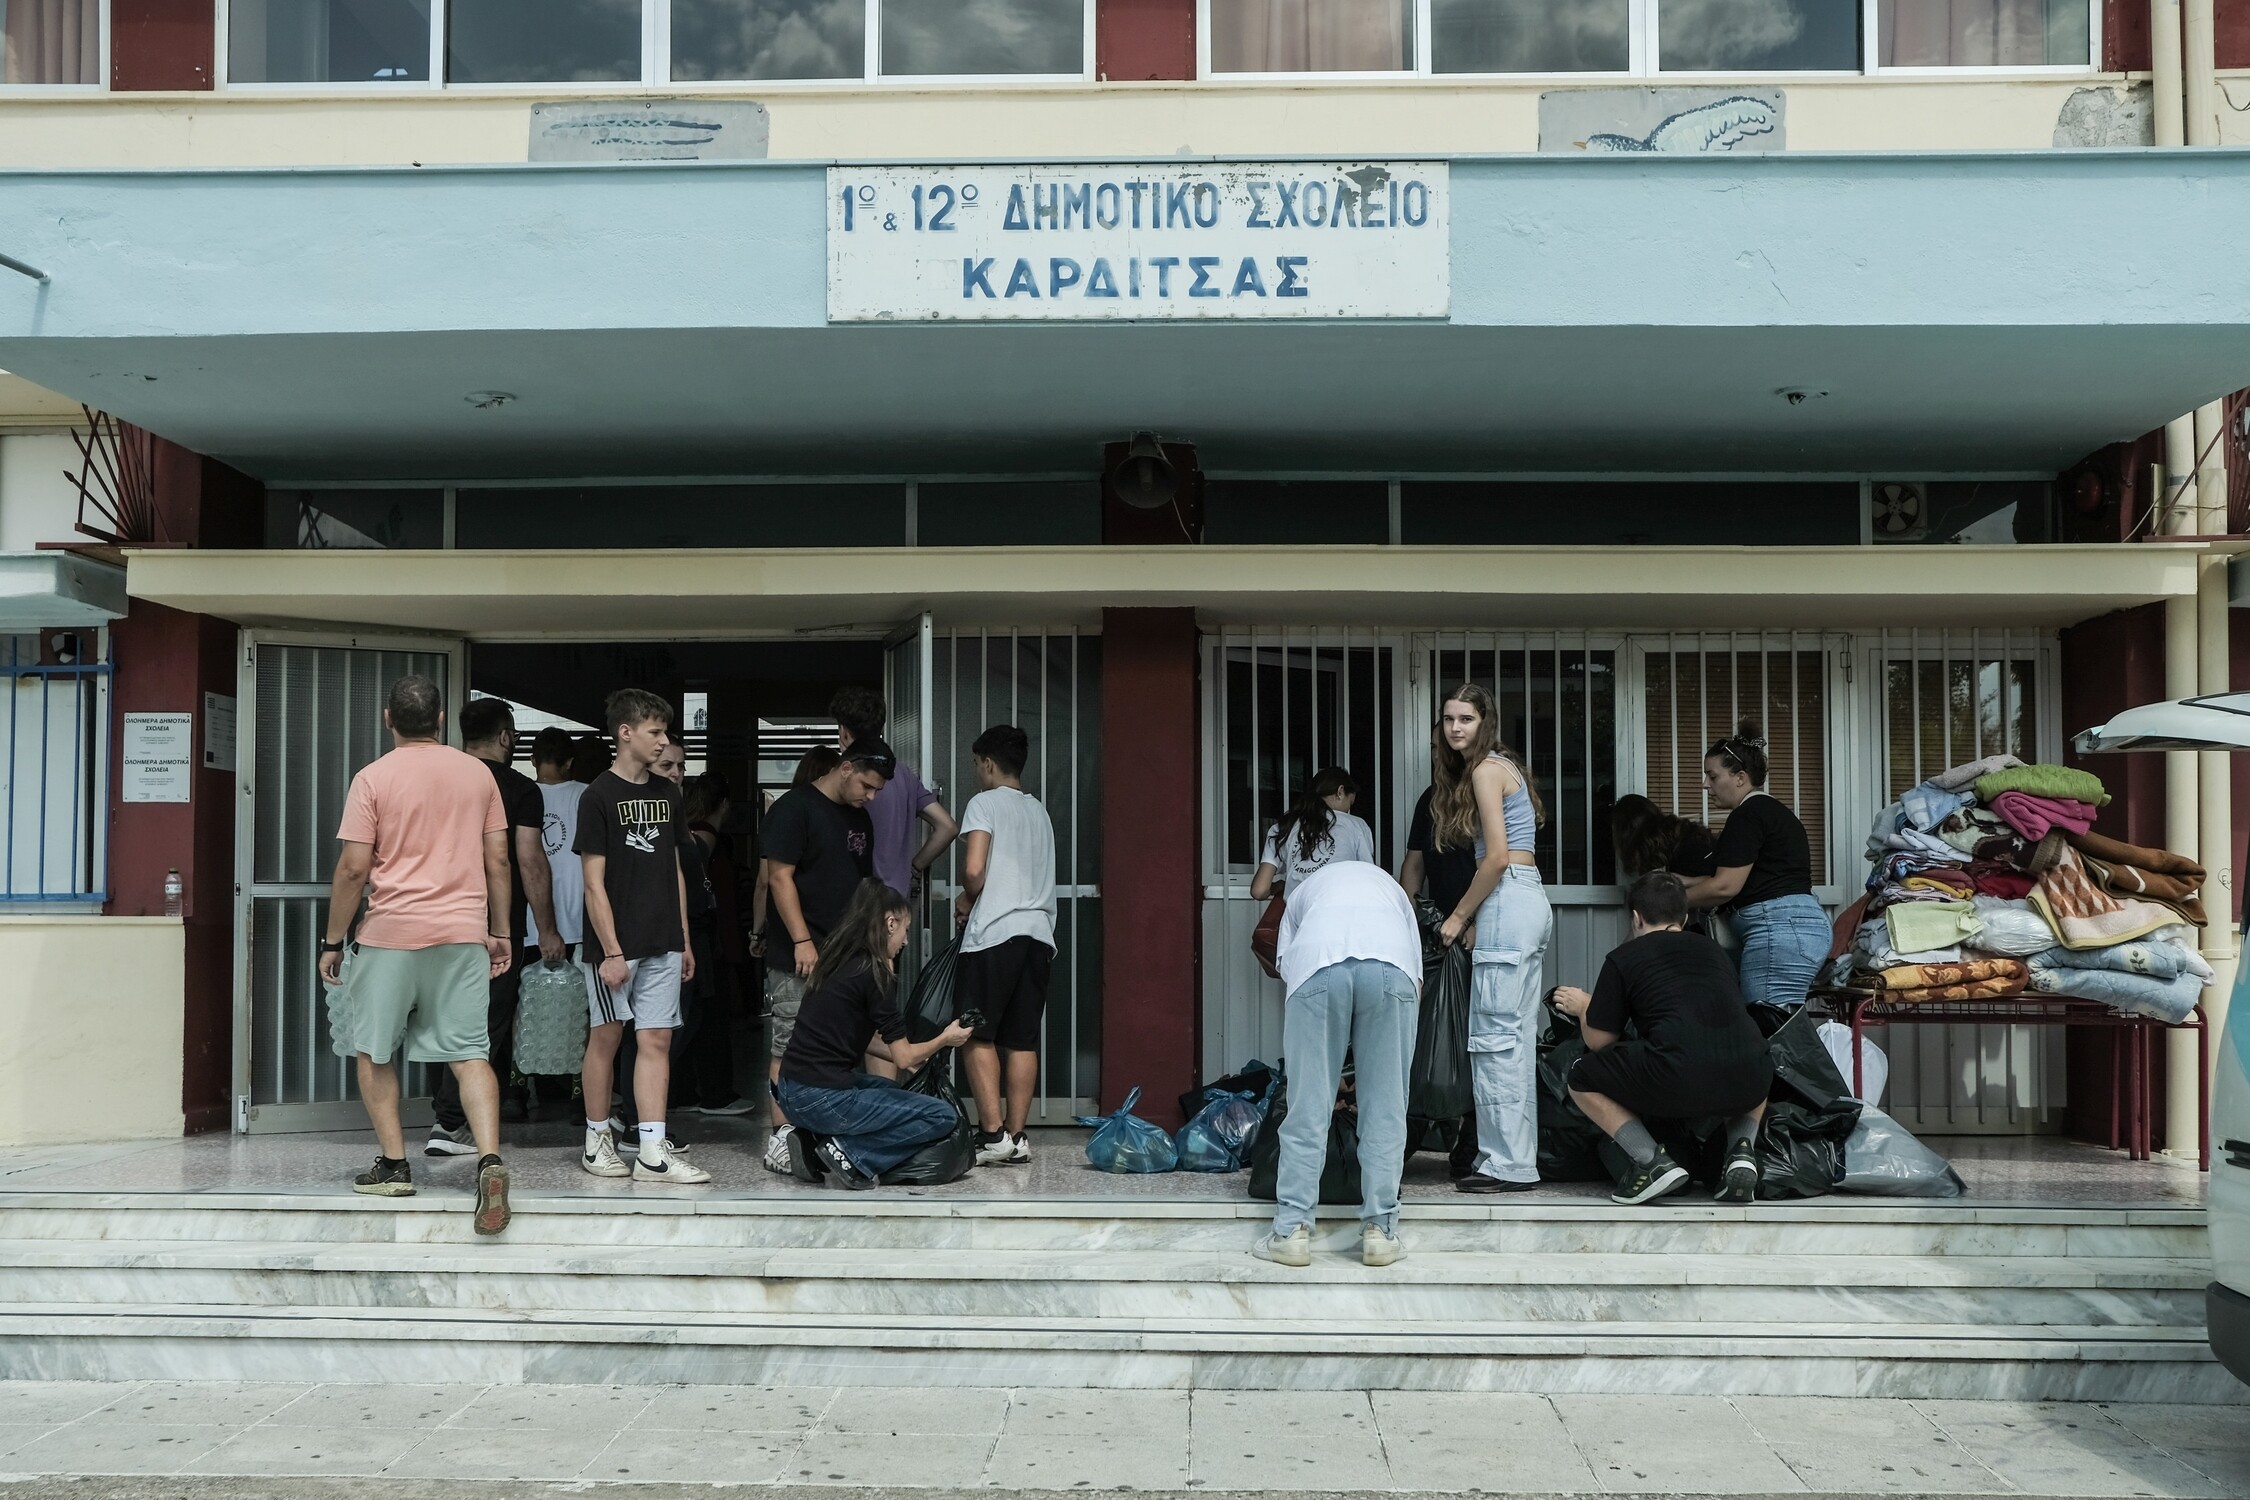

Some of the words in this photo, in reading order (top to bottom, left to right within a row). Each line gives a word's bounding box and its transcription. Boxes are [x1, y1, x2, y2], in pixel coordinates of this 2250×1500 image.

[883, 212, 898, 232] &
[1002, 183, 1221, 231] ΔΗΜΟΤΙΚΟ
[1246, 180, 1429, 229] ΣΧΟΛΕΙΟ
[962, 257, 1309, 299] ΚΑΡΔΙΤΣΑΣ
[617, 799, 671, 826] PUMA
